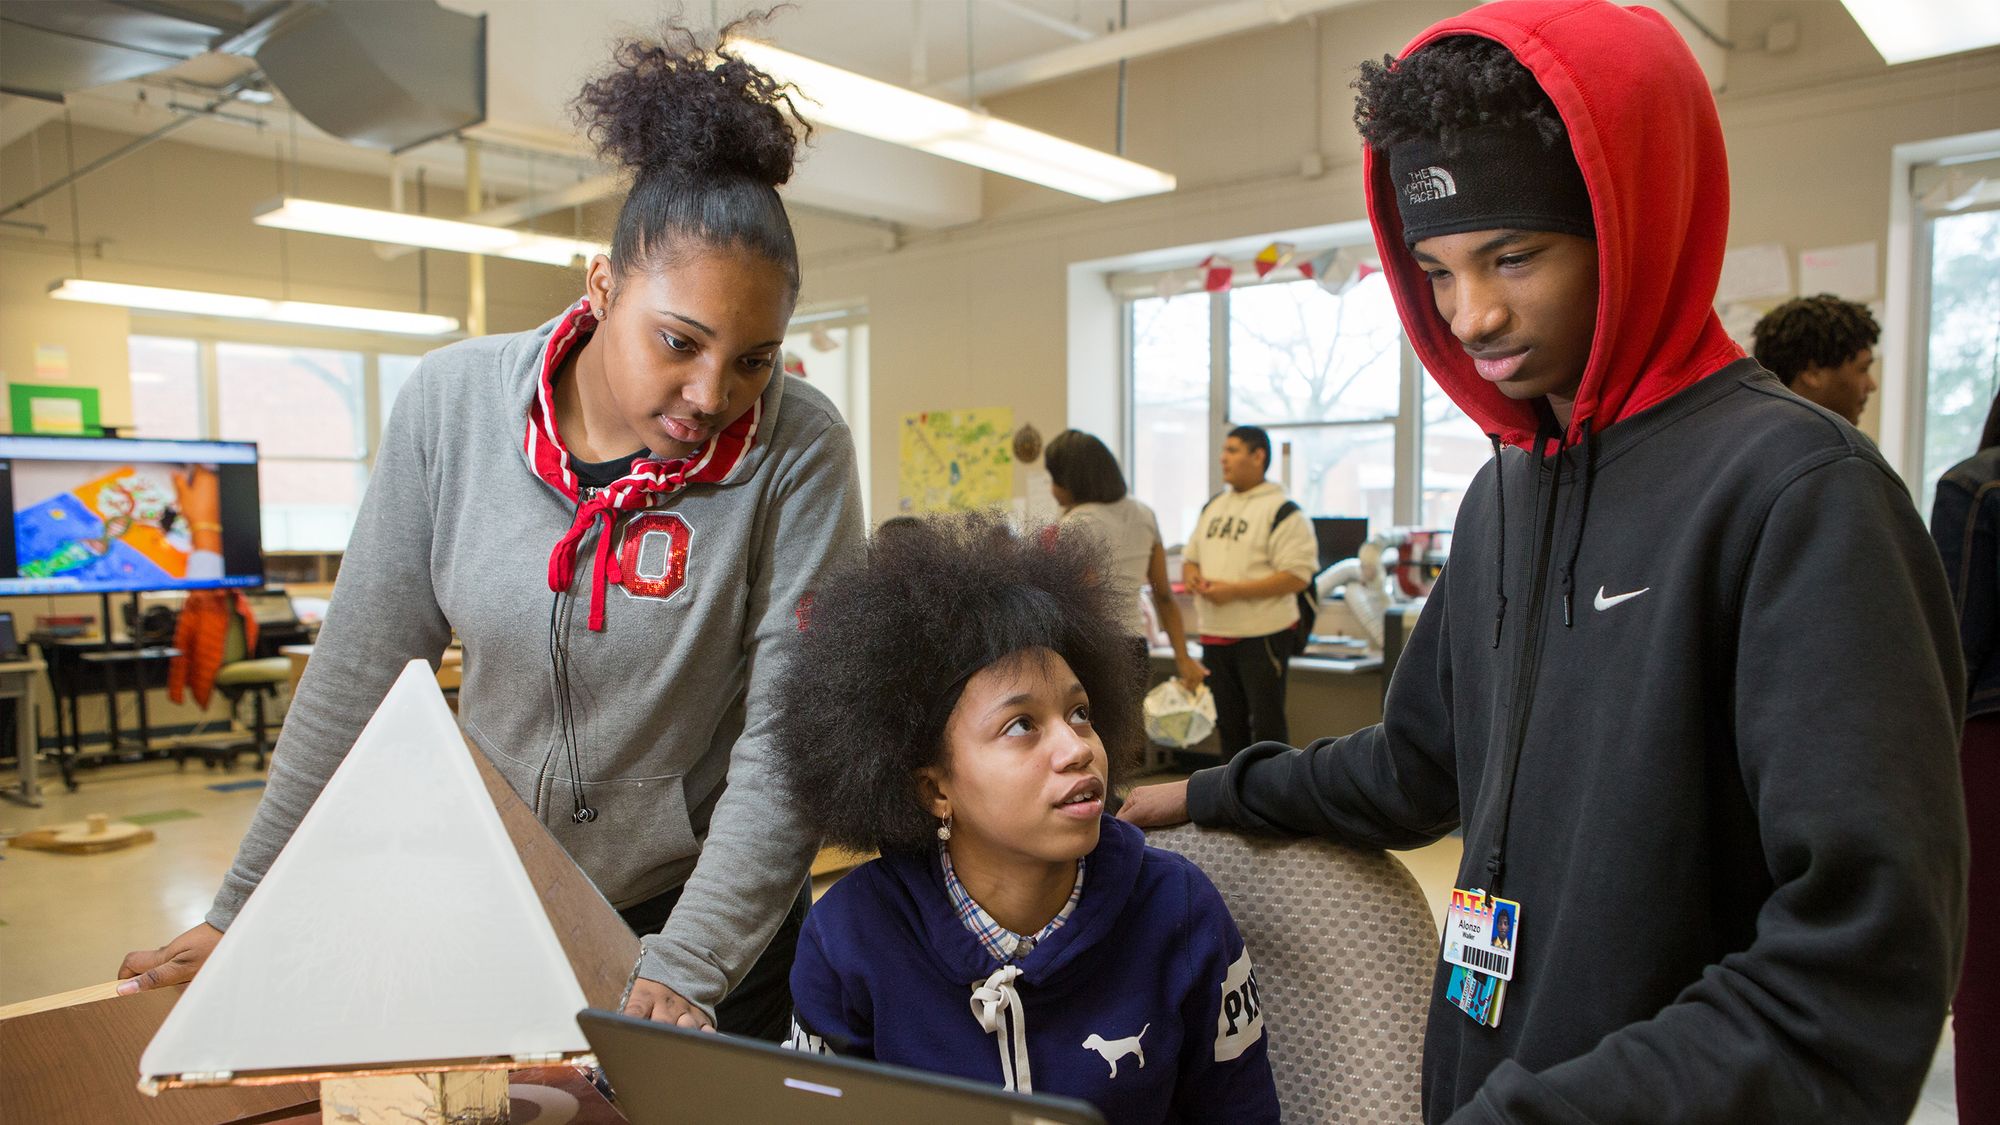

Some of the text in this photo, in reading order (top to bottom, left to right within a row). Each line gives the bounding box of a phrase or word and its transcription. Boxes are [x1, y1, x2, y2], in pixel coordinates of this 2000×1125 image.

[1408, 168, 1430, 181] THE
[1402, 179, 1433, 196] NORTH
[1409, 190, 1434, 205] FACE
[1206, 516, 1248, 541] GAP
[617, 511, 695, 602] O
[1458, 919, 1481, 934] Alonzo
[1224, 967, 1260, 1037] PIN
